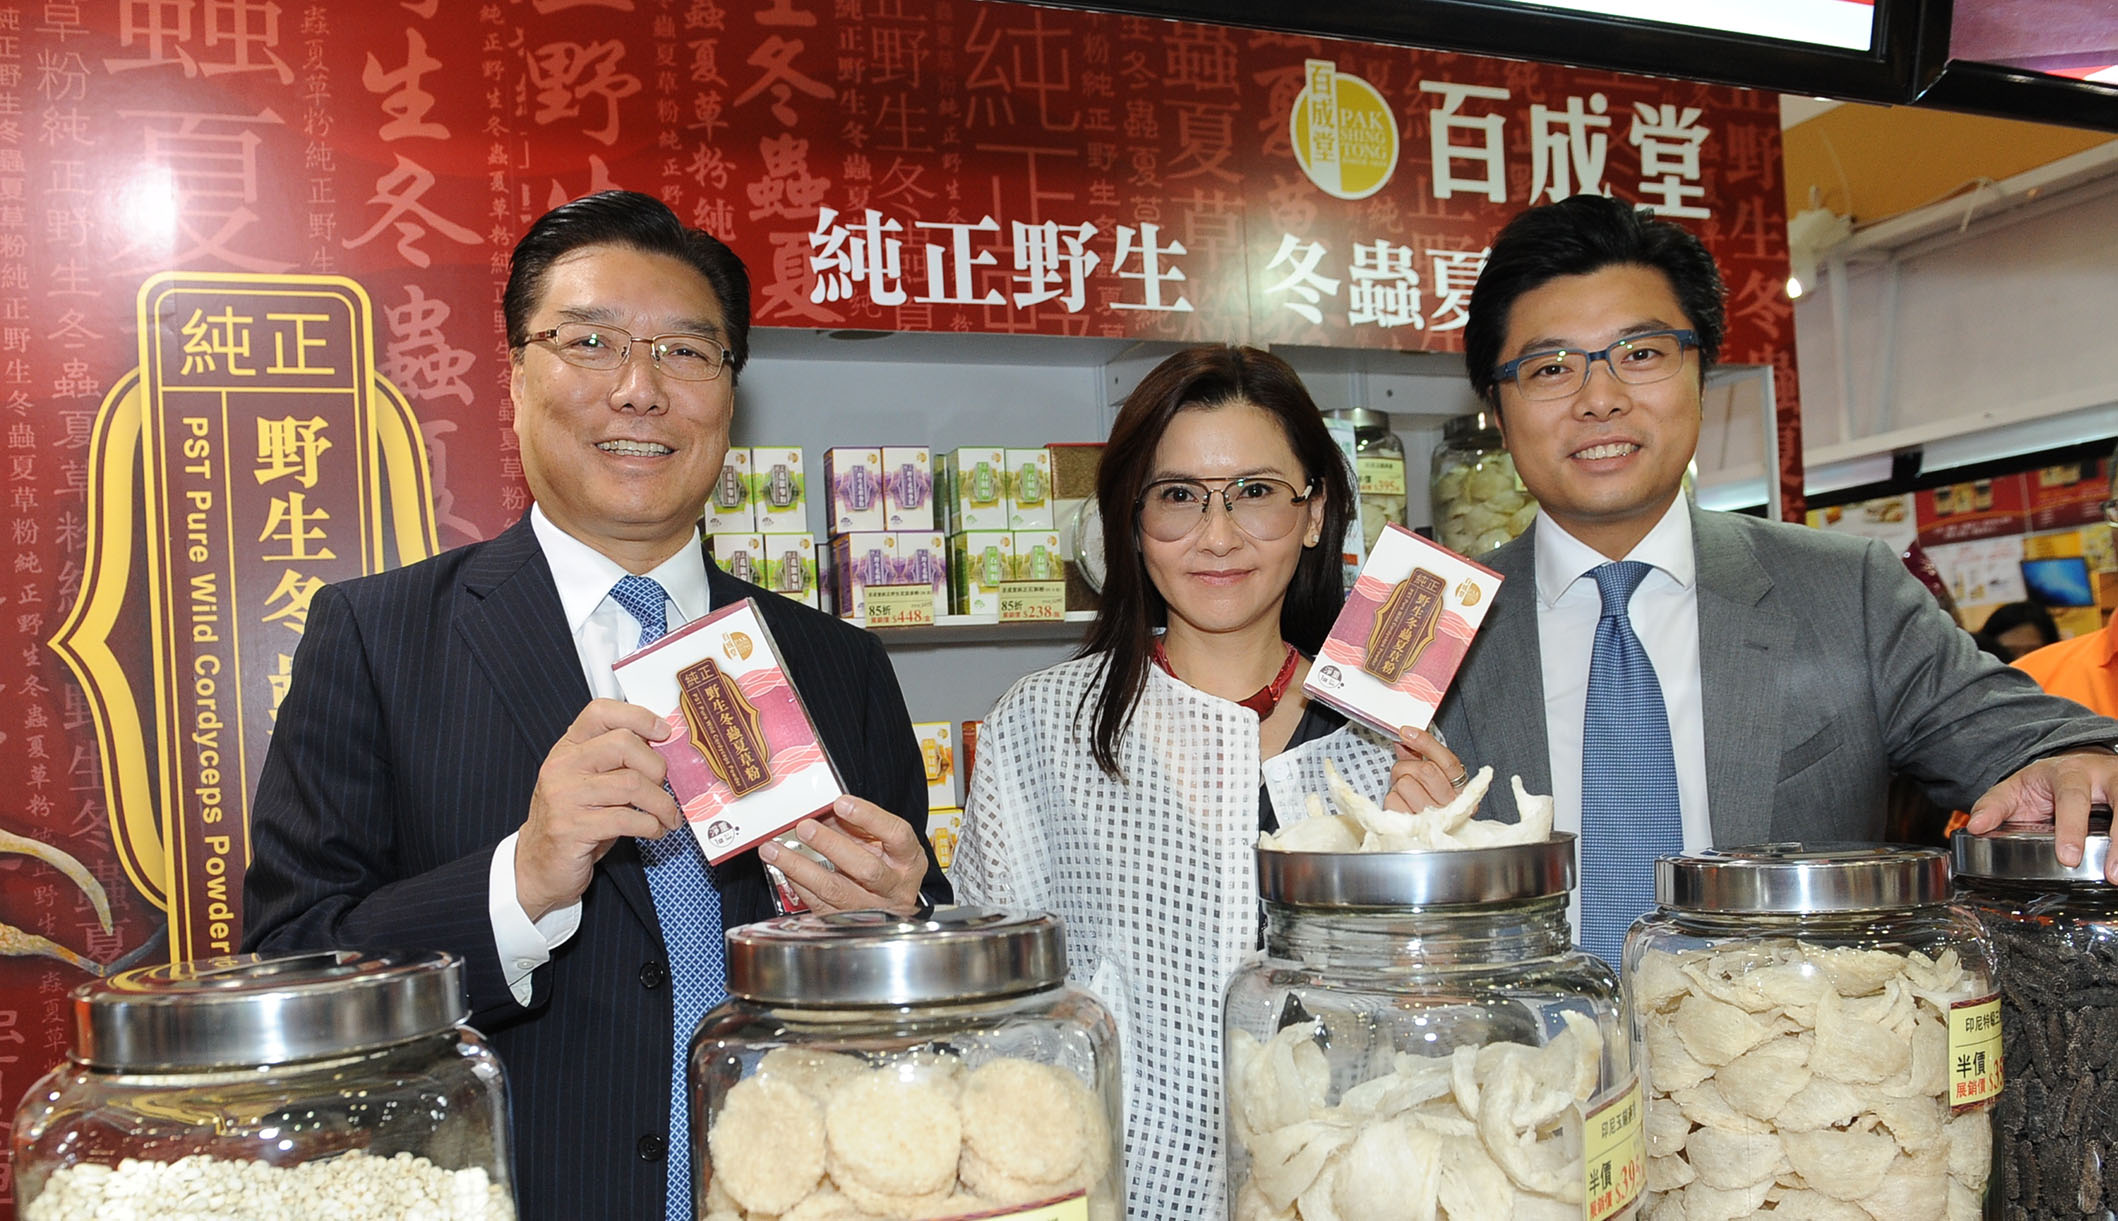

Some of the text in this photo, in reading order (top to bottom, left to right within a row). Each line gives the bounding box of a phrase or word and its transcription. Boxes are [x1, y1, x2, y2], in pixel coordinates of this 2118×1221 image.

[1310, 64, 1335, 163] 百成堂
[1340, 107, 1384, 130] PAK
[1340, 142, 1388, 159] TONG
[1419, 79, 1711, 220] 百成堂
[808, 206, 1195, 313] 純正野生
[180, 305, 336, 377] 純正
[1413, 573, 1441, 593] 純正
[183, 417, 236, 956] PST Pure Wild Cordyceps Powder
[684, 663, 715, 689] 純正
[703, 683, 761, 782] 野生冬蟲夏草粉
[1956, 1051, 1986, 1079] 半價
[1956, 1077, 1987, 1099] 展銷價
[1589, 1160, 1612, 1197] 半價
